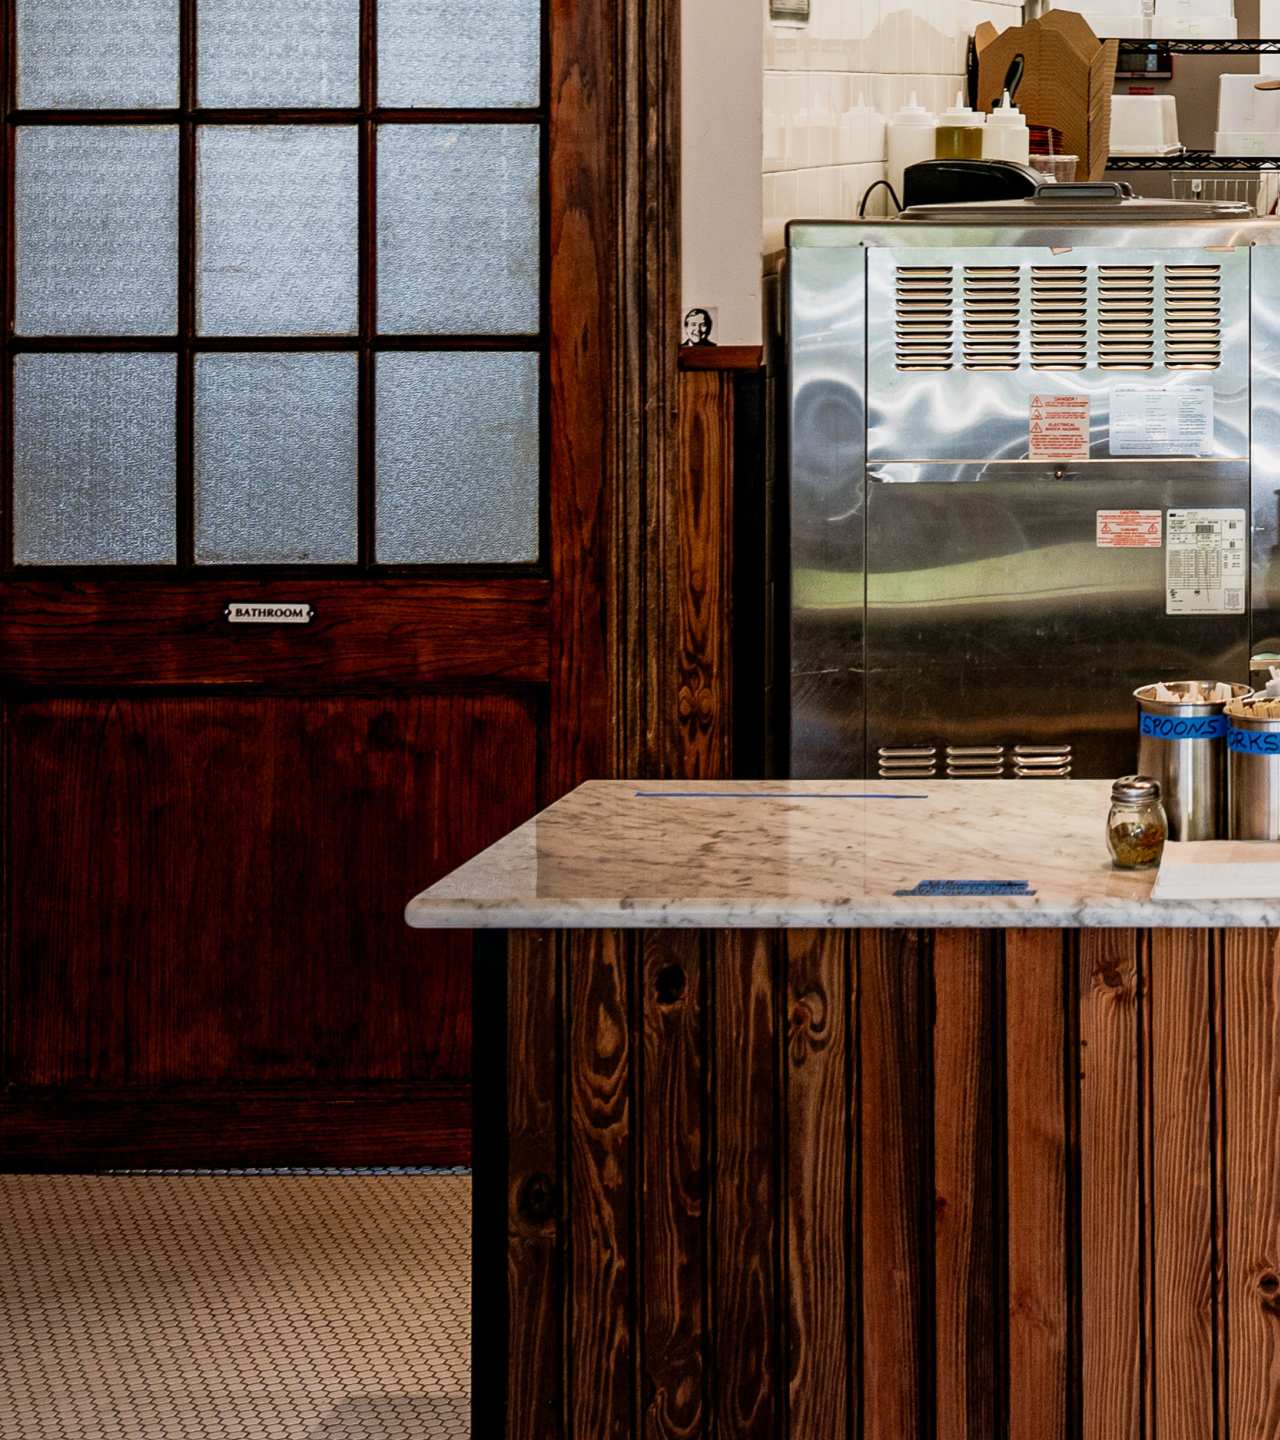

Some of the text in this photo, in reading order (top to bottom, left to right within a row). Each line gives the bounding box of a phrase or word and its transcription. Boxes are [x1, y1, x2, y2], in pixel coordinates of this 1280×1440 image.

[235, 608, 304, 618] BATHROOM
[1142, 716, 1220, 738] SPOONS
[1228, 732, 1280, 752] ORKS
